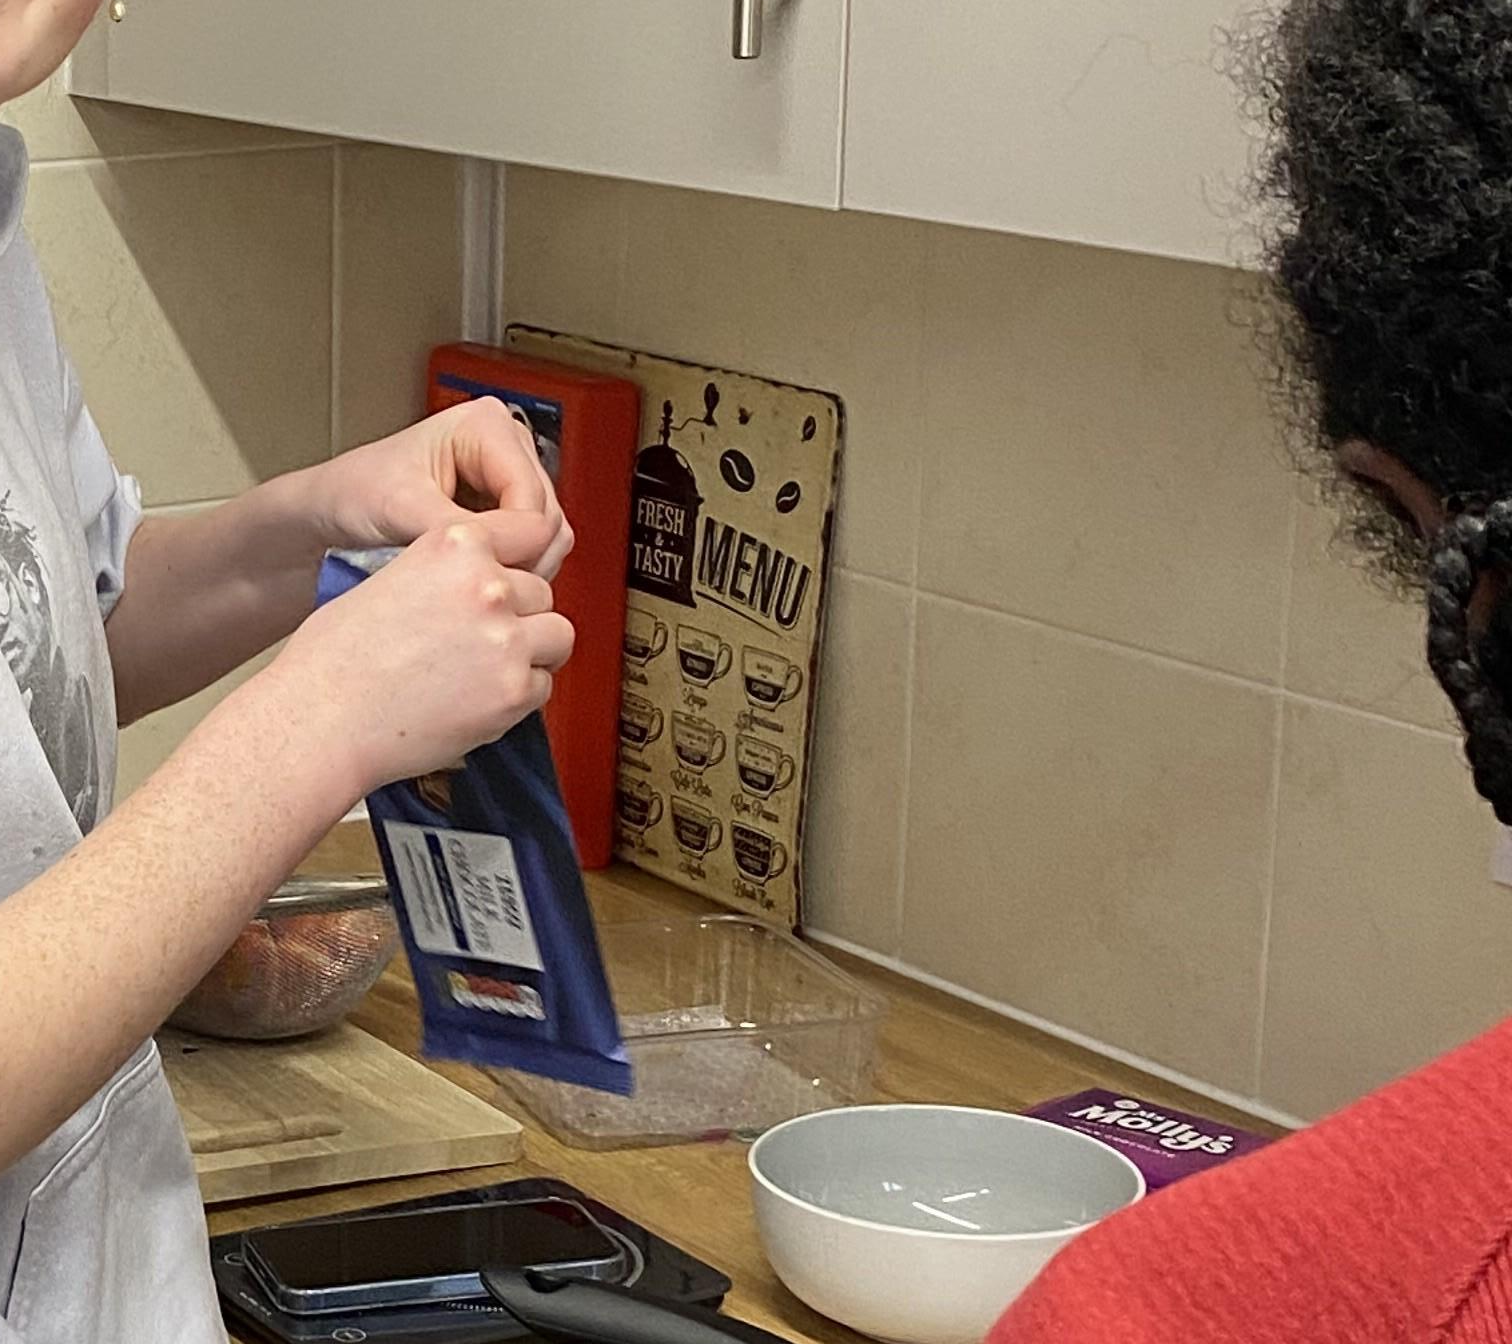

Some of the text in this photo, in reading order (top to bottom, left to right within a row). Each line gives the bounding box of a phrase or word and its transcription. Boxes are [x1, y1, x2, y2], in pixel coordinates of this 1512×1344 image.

[637, 498, 685, 536] FRESH
[633, 543, 684, 581] TASTY
[697, 516, 812, 630] MENU
[1067, 1105, 1234, 1155] Molly's
